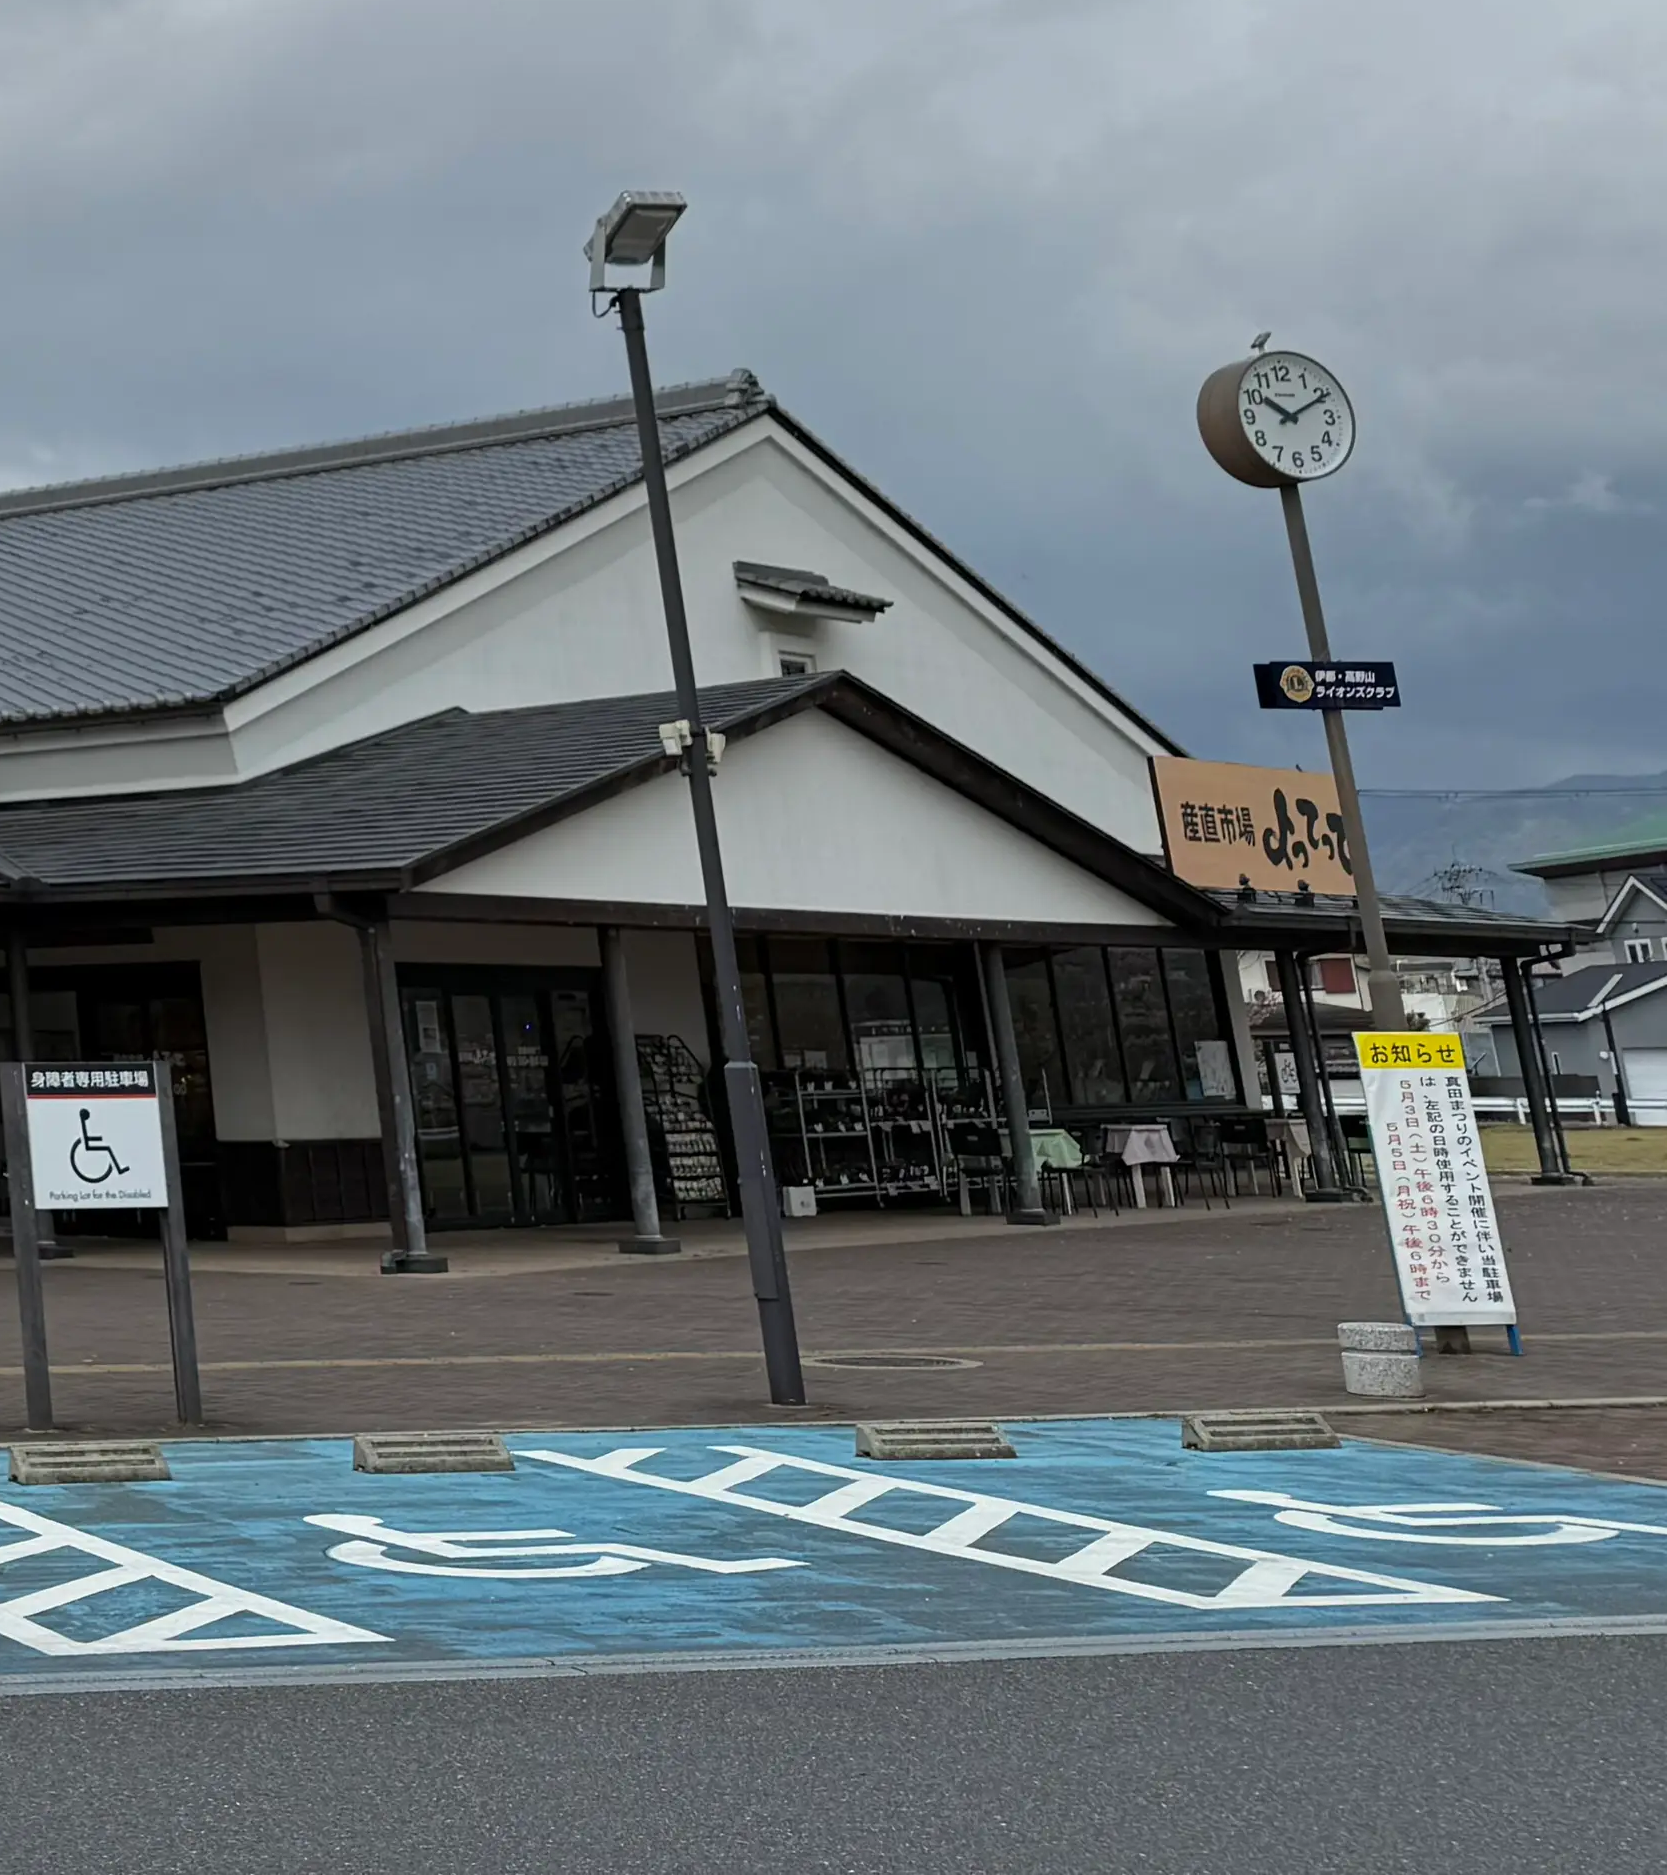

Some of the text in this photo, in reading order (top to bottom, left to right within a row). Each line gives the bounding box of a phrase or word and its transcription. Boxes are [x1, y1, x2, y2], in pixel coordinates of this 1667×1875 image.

[1253, 372, 1270, 389] 11
[1270, 365, 1291, 382] 12
[1299, 373, 1307, 389] 1
[1243, 388, 1263, 405] 10
[1313, 387, 1327, 403] 2
[1244, 409, 1256, 425] 9
[1323, 409, 1336, 426] 3
[1254, 430, 1267, 447] 8
[1321, 430, 1332, 447] 4
[1272, 446, 1284, 462] 7
[1292, 451, 1304, 468] 6
[1310, 445, 1323, 462] 5
[1315, 686, 1396, 698] ライオンズクラブ
[1180, 800, 1256, 847] 産直市場
[1370, 1043, 1456, 1064] お知らせ
[30, 1070, 149, 1088] 身障者専用駐車場
[49, 1191, 79, 1202] Parking
[93, 1189, 105, 1200] for
[106, 1190, 117, 1199] the
[119, 1189, 151, 1199] Disabled
